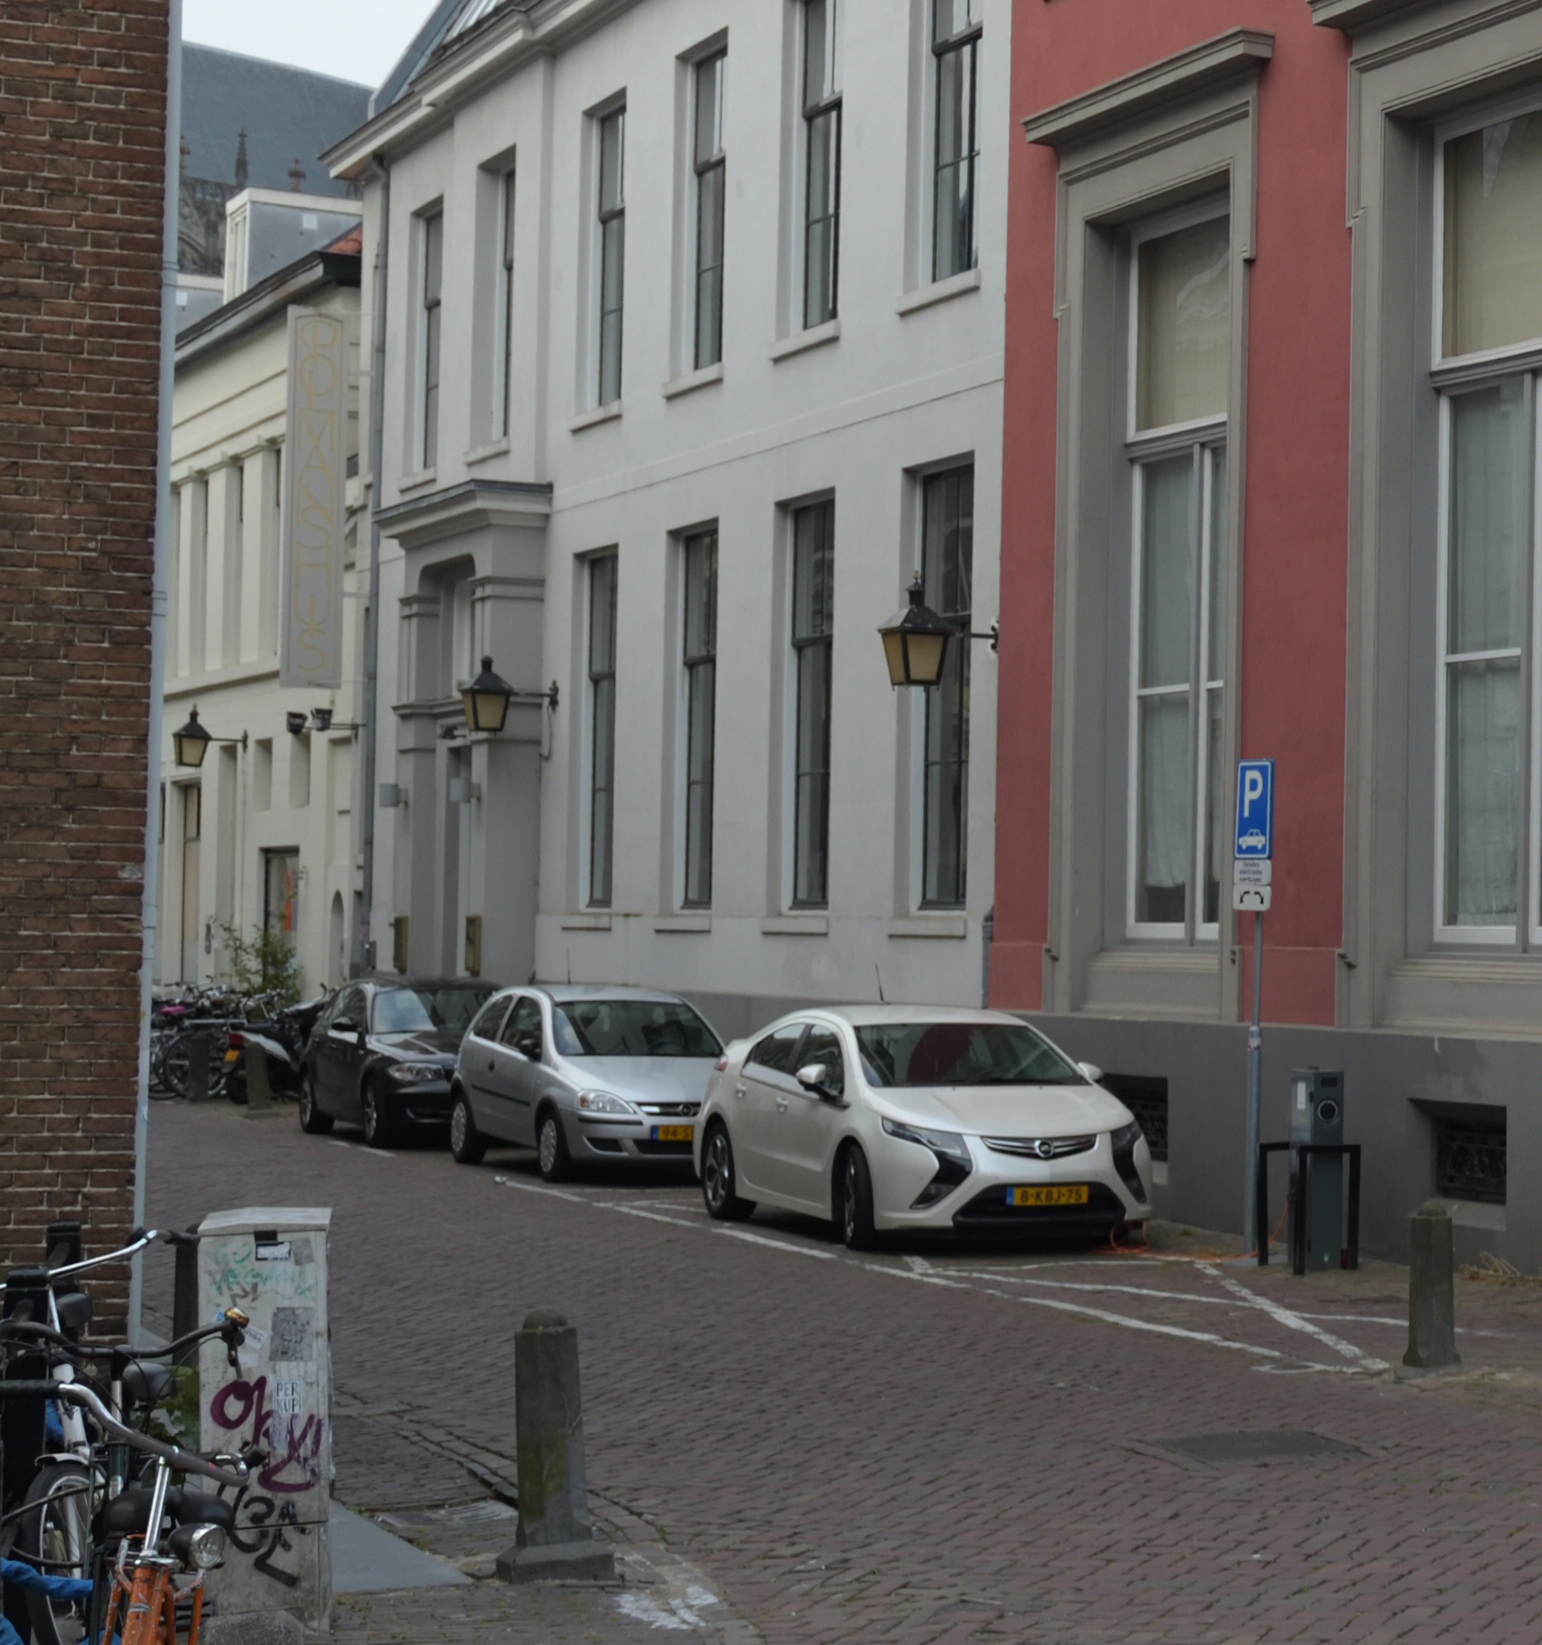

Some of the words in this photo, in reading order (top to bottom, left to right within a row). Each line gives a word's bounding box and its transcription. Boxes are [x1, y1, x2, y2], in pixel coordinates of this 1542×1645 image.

[1243, 769, 1263, 817] P
[1020, 1188, 1083, 1203] 8-KBJ-75
[276, 1381, 299, 1397] PER
